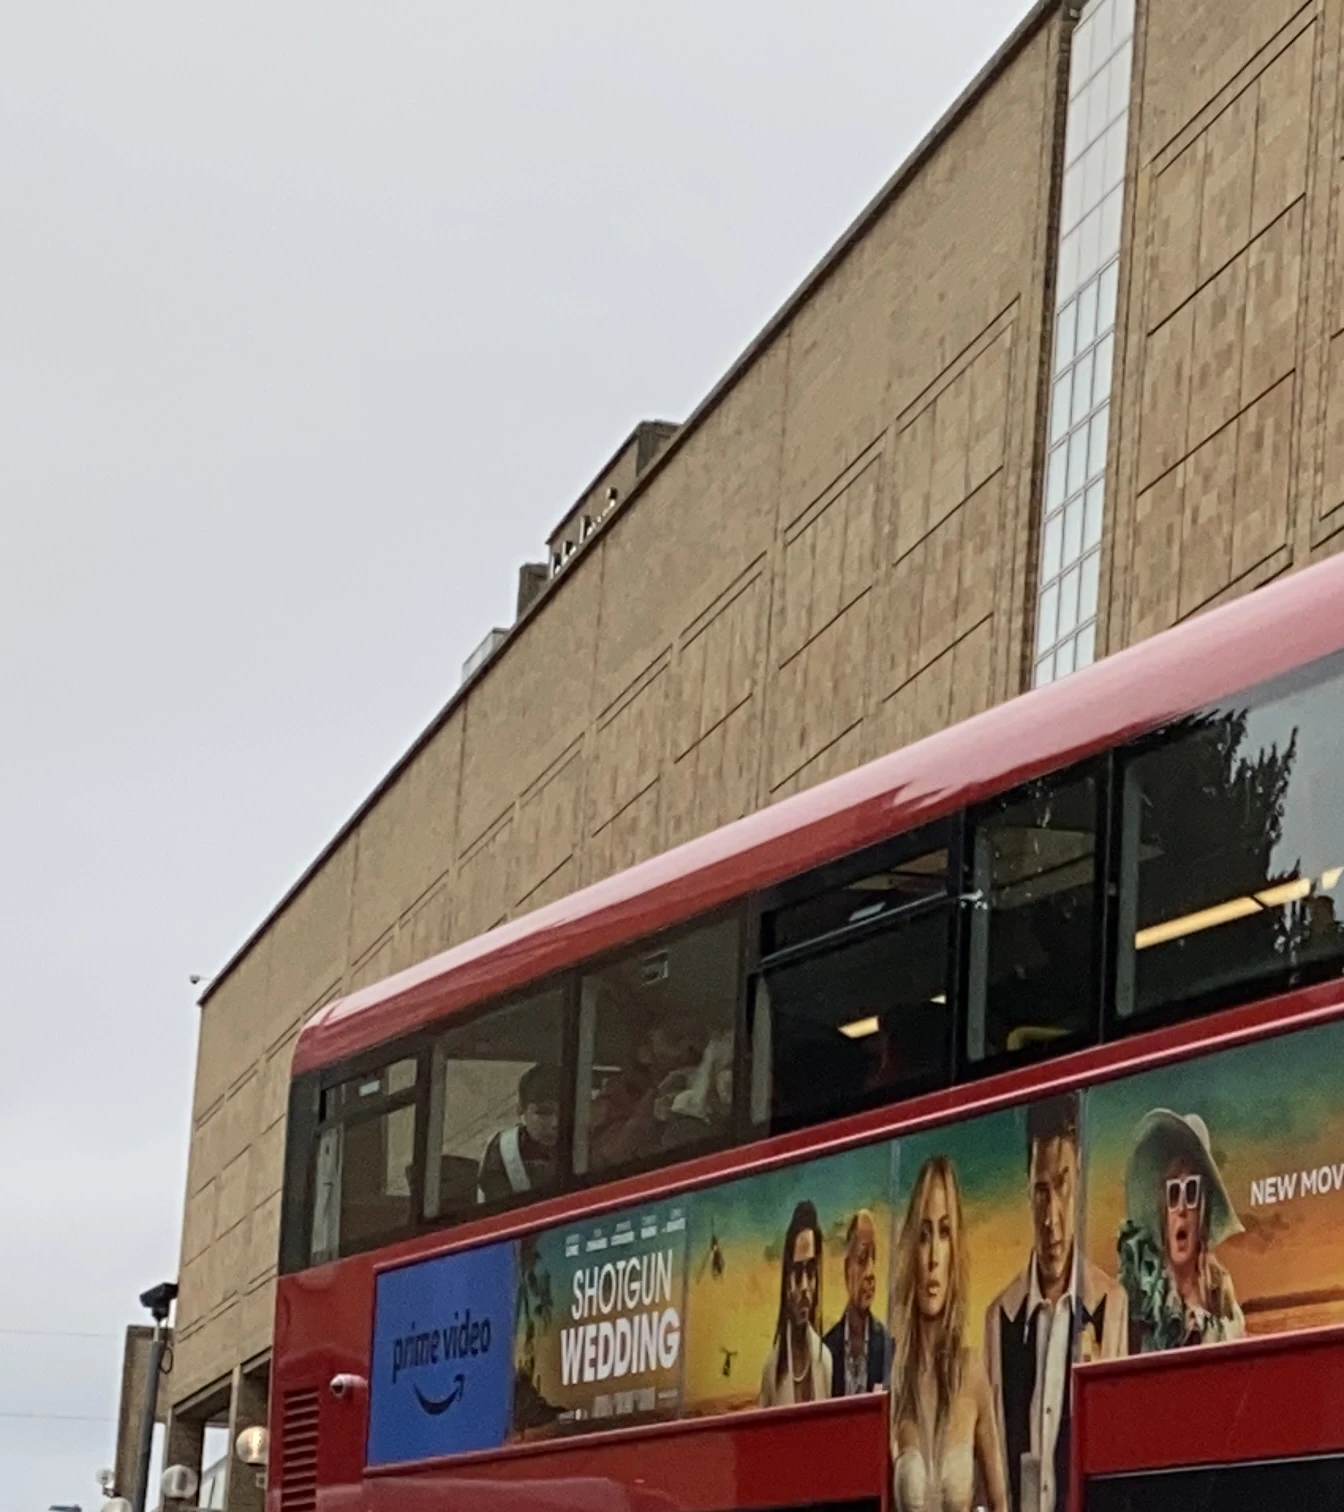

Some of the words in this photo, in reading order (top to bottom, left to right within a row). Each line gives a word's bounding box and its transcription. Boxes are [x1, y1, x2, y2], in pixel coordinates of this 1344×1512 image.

[1250, 1172, 1298, 1207] NEW
[571, 1249, 673, 1321] SHOTGUN
[391, 1320, 440, 1384] prime
[442, 1308, 492, 1366] video
[560, 1307, 681, 1387] WEDDING
